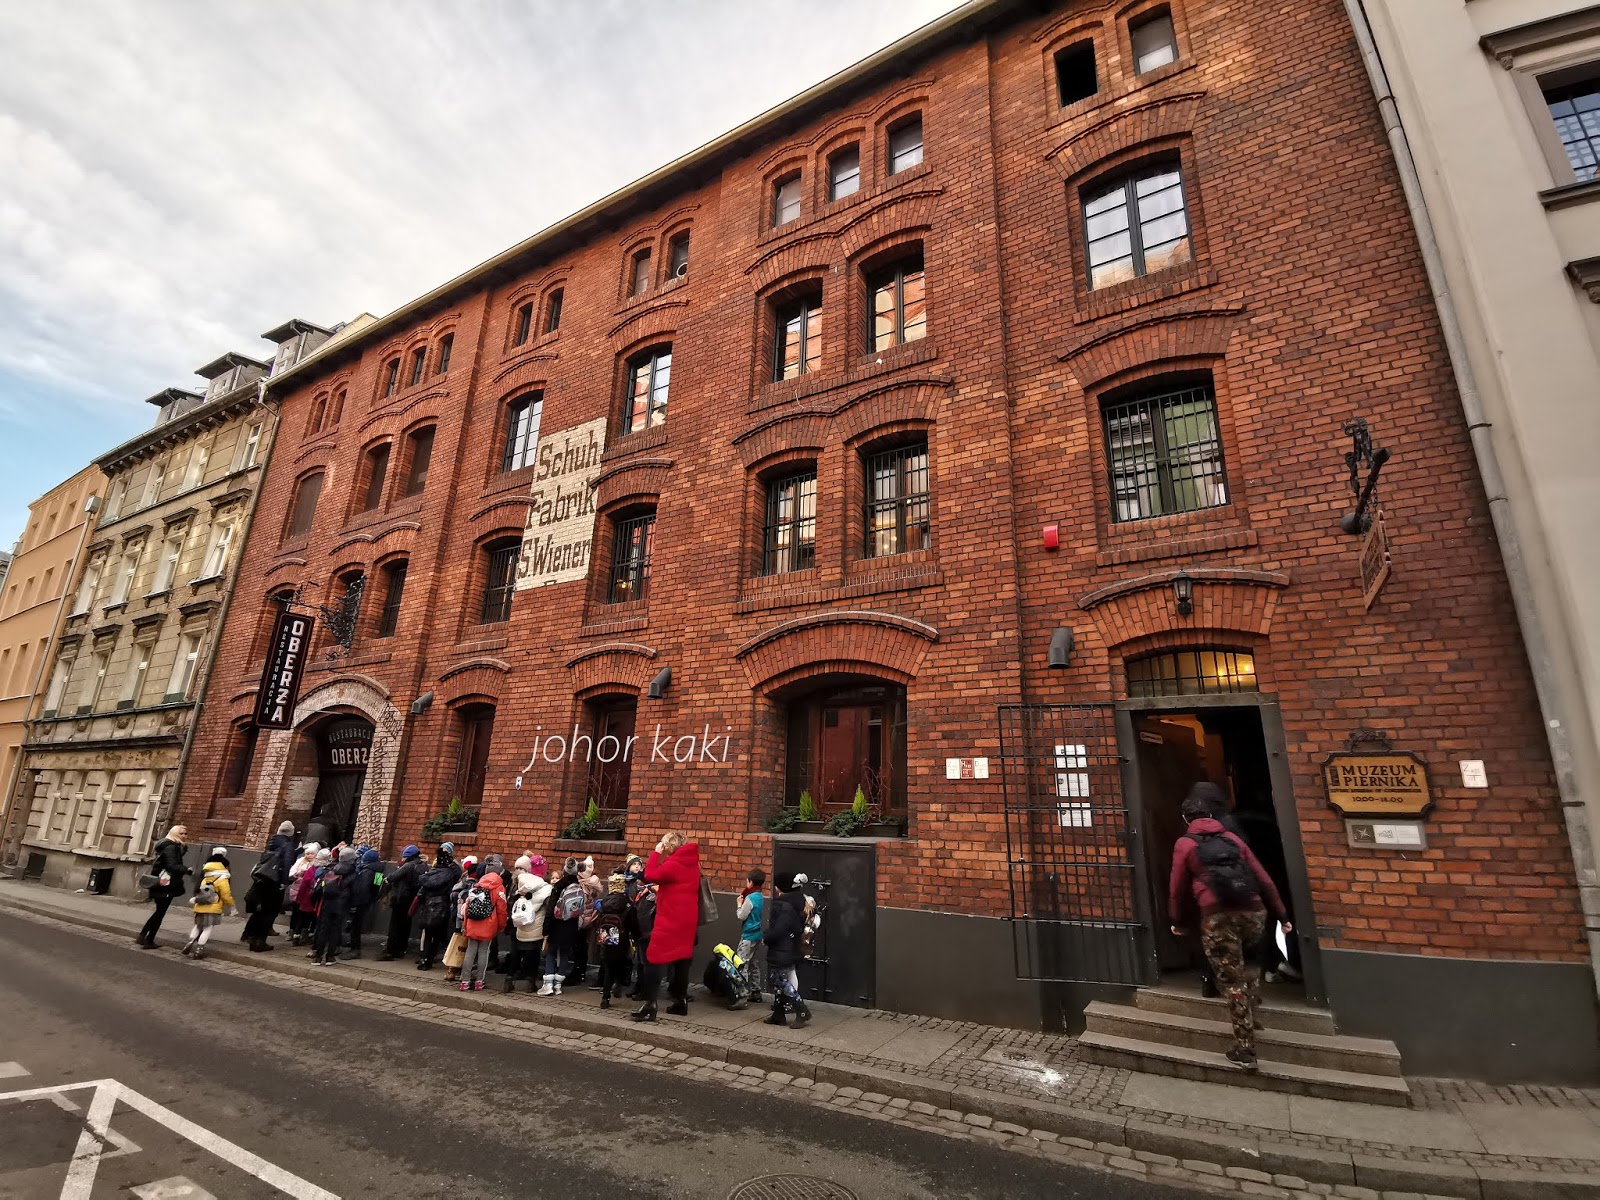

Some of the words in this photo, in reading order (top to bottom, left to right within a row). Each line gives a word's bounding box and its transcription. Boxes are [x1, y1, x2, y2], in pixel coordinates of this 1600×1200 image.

[536, 430, 598, 482] Schuh
[525, 476, 599, 530] Fabrik
[264, 625, 289, 714] RESTAURACJA
[328, 728, 371, 744] RESTAURACJ
[1341, 765, 1416, 776] MUZEUM
[1344, 776, 1418, 787] PIERNIKA
